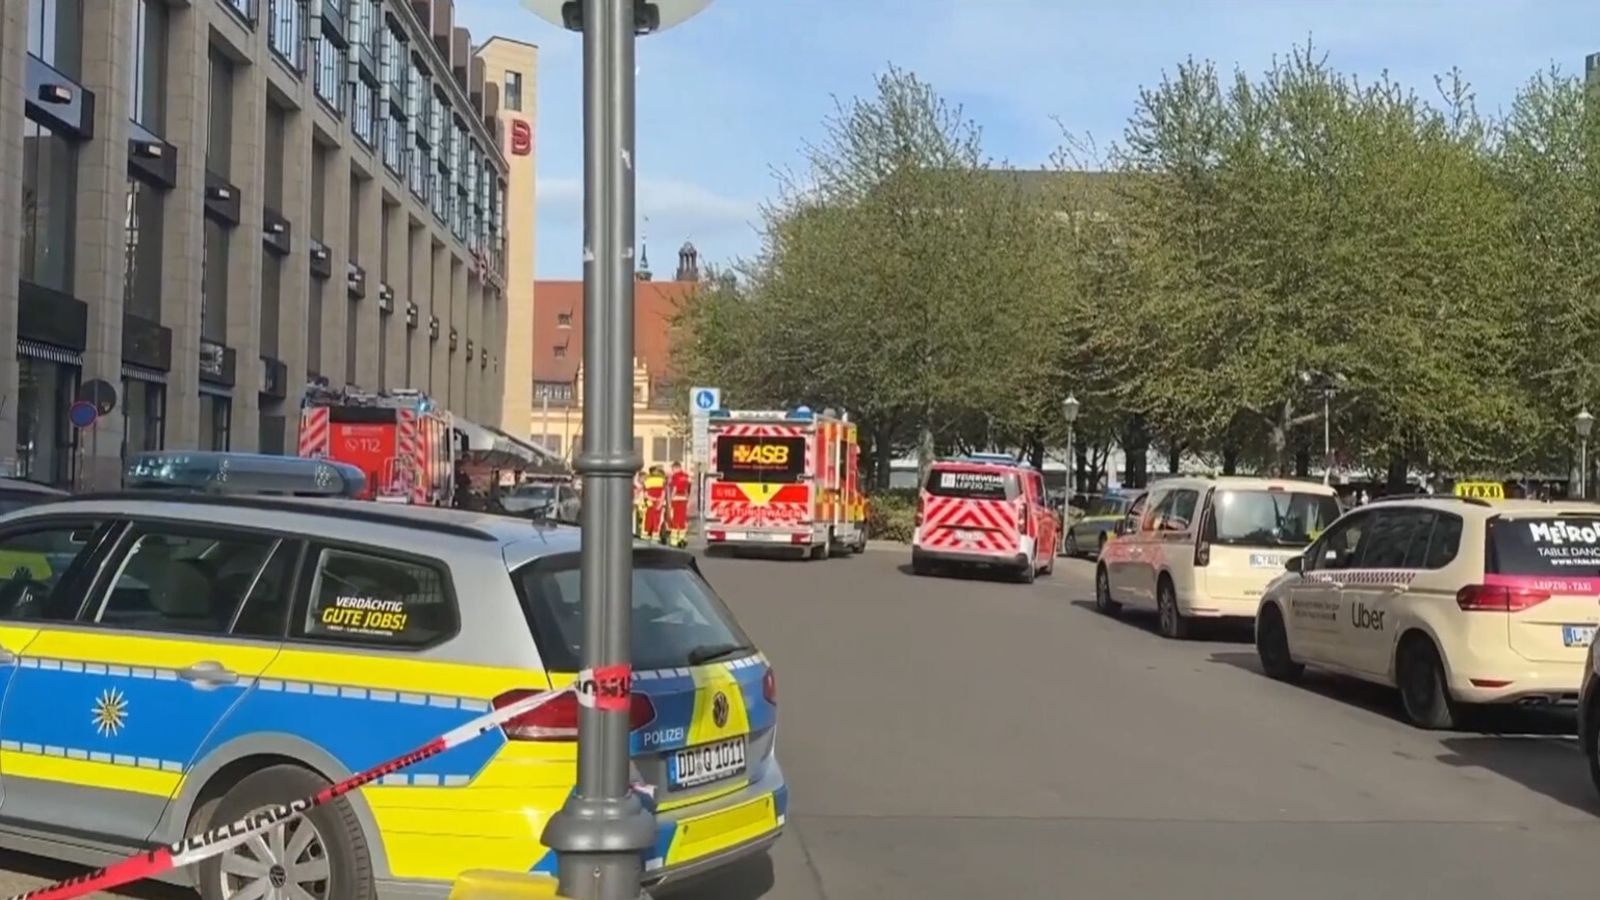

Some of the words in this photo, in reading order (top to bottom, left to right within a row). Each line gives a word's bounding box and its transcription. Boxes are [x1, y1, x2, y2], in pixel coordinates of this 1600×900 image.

[360, 438, 380, 453] 112
[745, 444, 789, 464] ASB
[955, 481, 983, 490] LEIPZIG
[956, 473, 1004, 484] FEUERWEHR
[1463, 485, 1499, 497] TAXI
[1537, 547, 1569, 557] TABLE
[1534, 581, 1567, 591] LEIPZIG
[1573, 582, 1592, 592] TAXI
[336, 596, 404, 612] VERDÄCHTIG
[322, 608, 363, 626] GUTE
[363, 611, 407, 631] JOBS!
[1352, 602, 1385, 630] Uber
[644, 728, 684, 746] POLIZEI
[678, 752, 695, 778] DD
[715, 740, 744, 769] 1011
